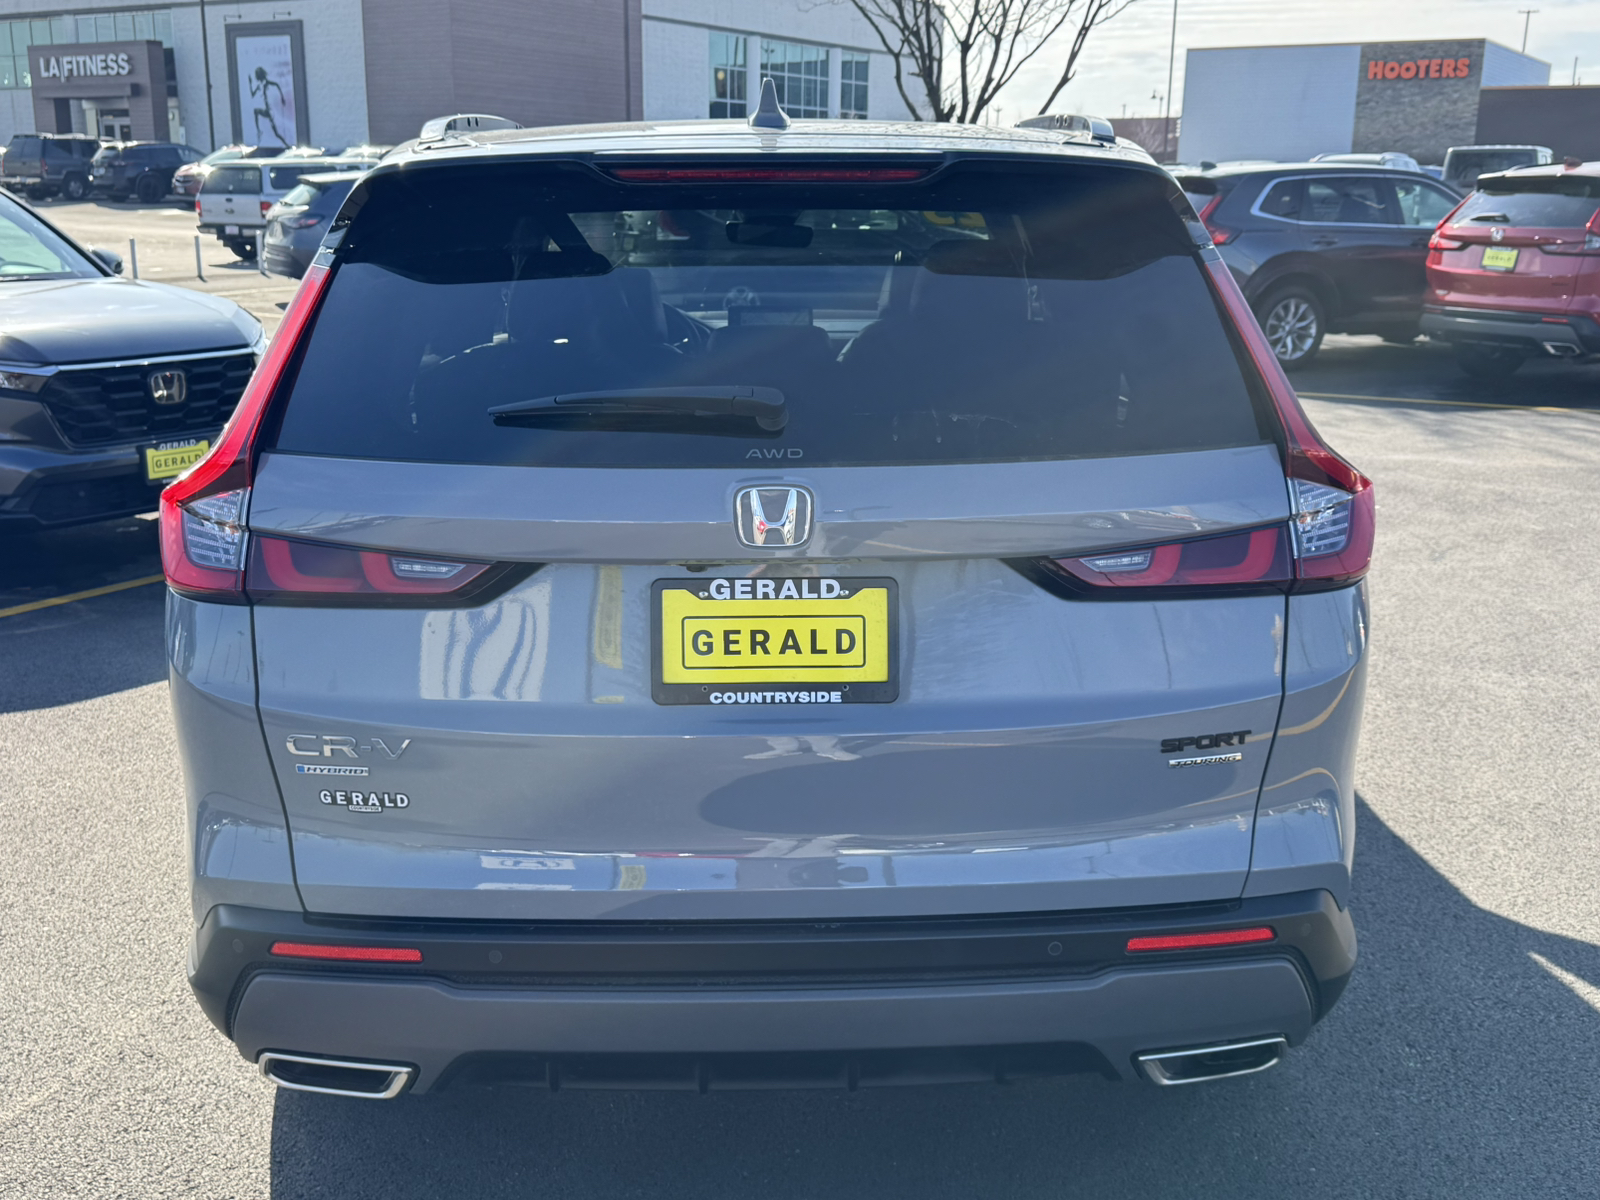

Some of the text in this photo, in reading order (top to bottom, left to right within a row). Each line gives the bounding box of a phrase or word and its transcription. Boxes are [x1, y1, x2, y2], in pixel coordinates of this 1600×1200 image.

[40, 56, 60, 78] LA
[1367, 58, 1470, 80] HOOTERS
[745, 448, 804, 459] AWD
[709, 578, 841, 600] GERALD
[691, 628, 857, 656] GERALD
[709, 690, 842, 705] COUNTRYSIDE
[286, 733, 412, 760] CR-V
[1160, 729, 1252, 754] SPORT
[306, 766, 364, 775] HYBRID
[1173, 755, 1238, 768] TOURING
[320, 790, 409, 807] GERALD
